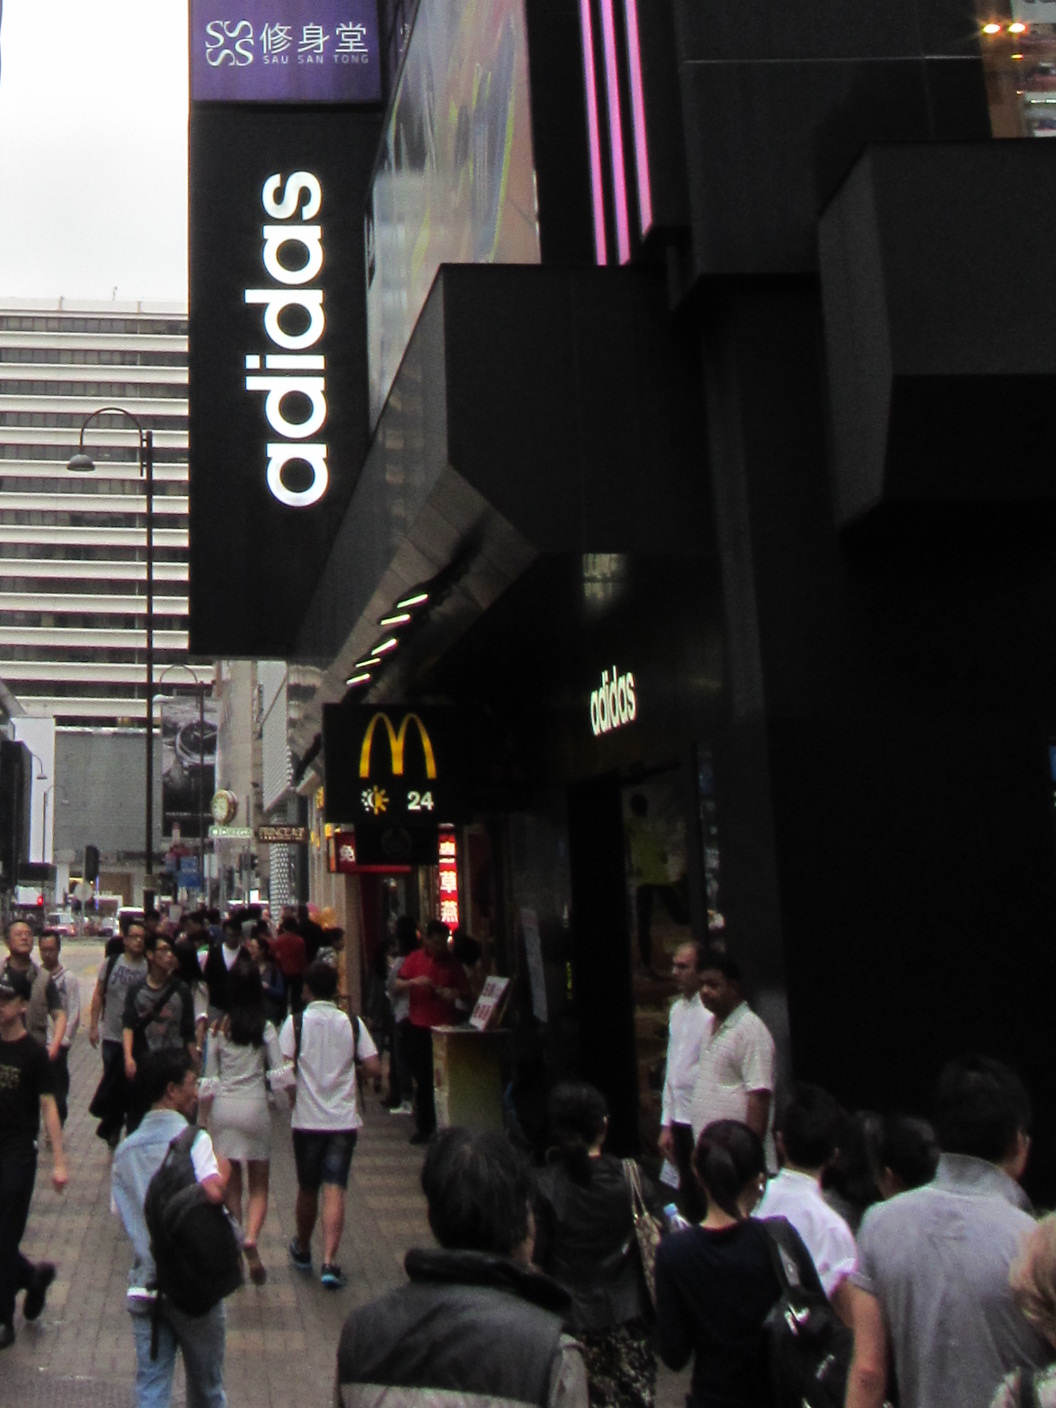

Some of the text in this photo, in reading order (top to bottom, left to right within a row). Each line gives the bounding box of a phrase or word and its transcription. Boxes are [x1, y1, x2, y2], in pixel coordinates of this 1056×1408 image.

[260, 22, 368, 53] 修身堂
[263, 54, 369, 65] SAU SAN TONG
[245, 170, 329, 507] adidas
[590, 665, 637, 736] adidas
[407, 791, 434, 811] 24
